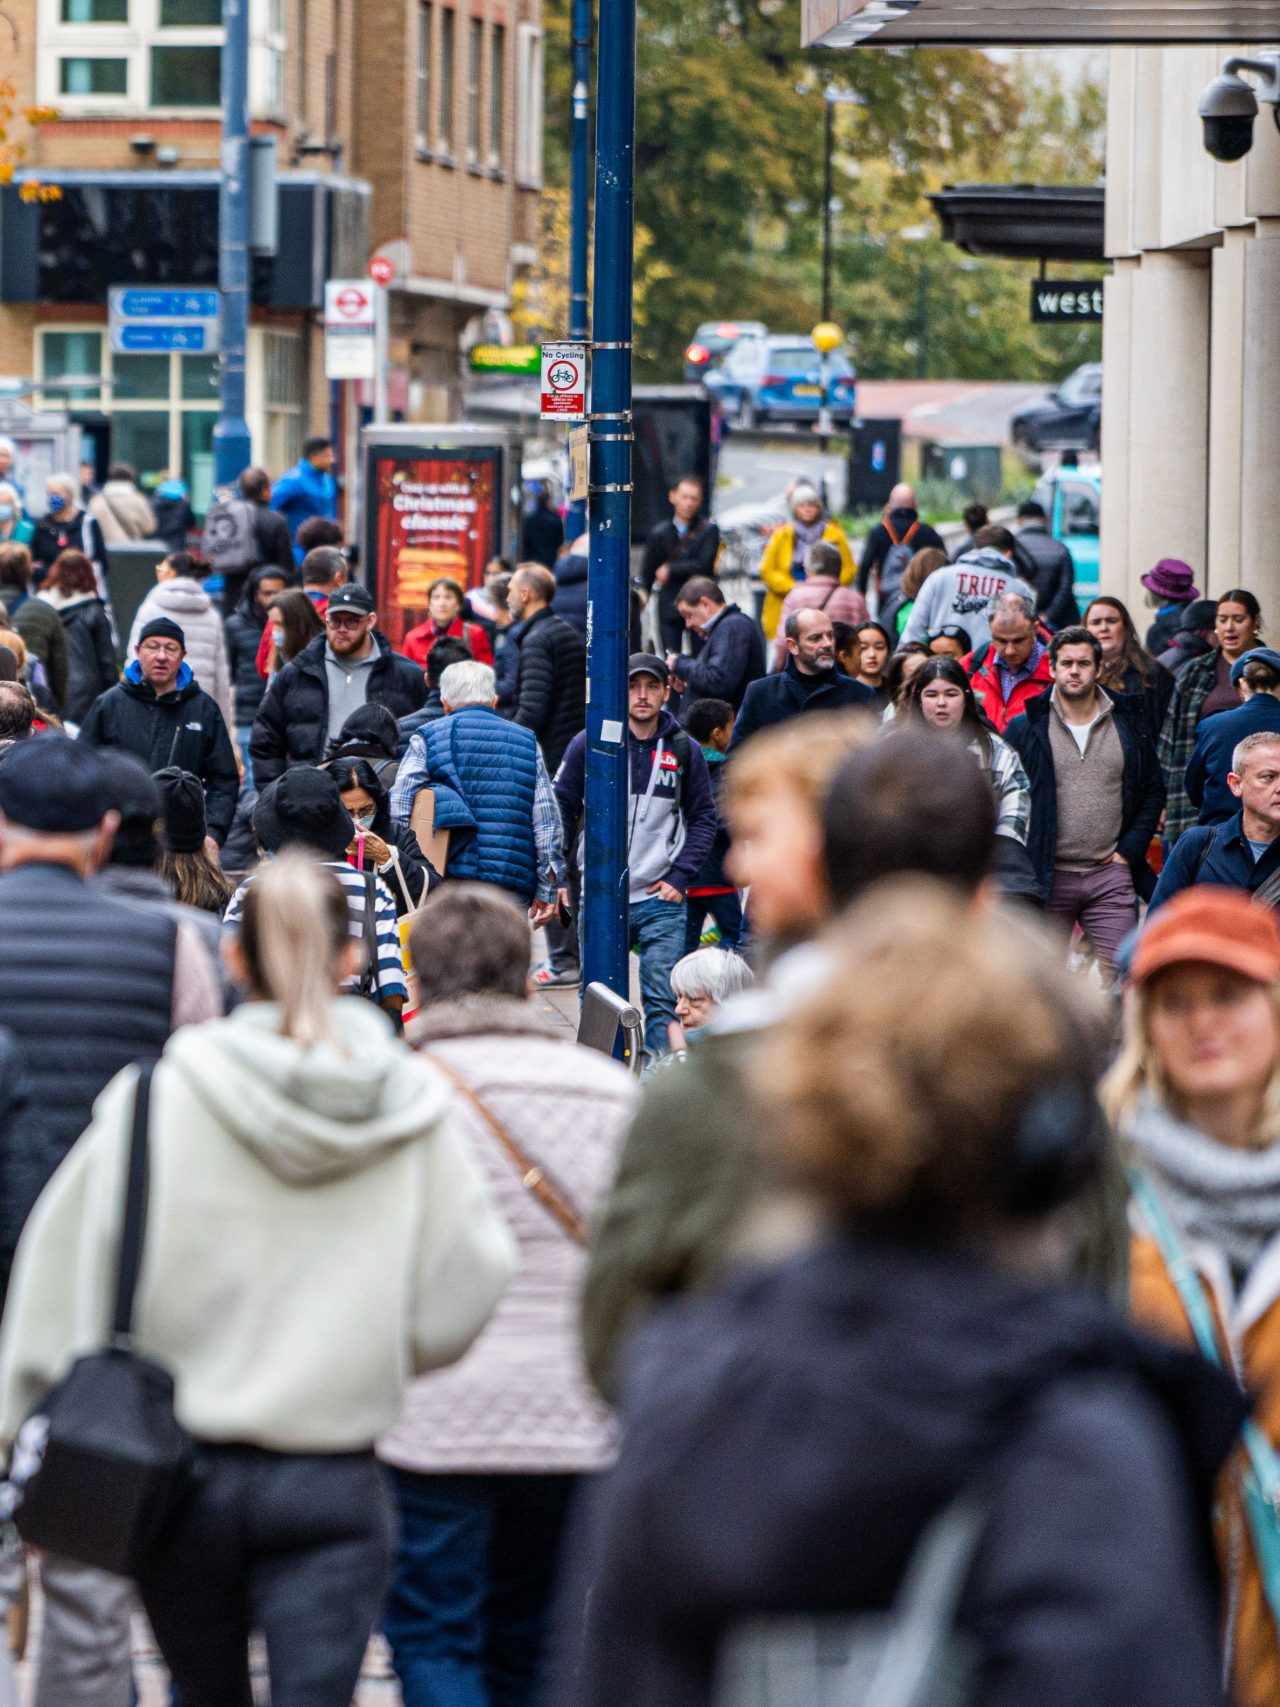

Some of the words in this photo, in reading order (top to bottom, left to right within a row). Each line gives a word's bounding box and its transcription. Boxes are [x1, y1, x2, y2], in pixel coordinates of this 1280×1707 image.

[1038, 291, 1103, 314] west
[542, 351, 553, 359] No
[555, 351, 584, 360] Cycling
[393, 495, 478, 513] Christmas
[956, 573, 1006, 597] TRUE
